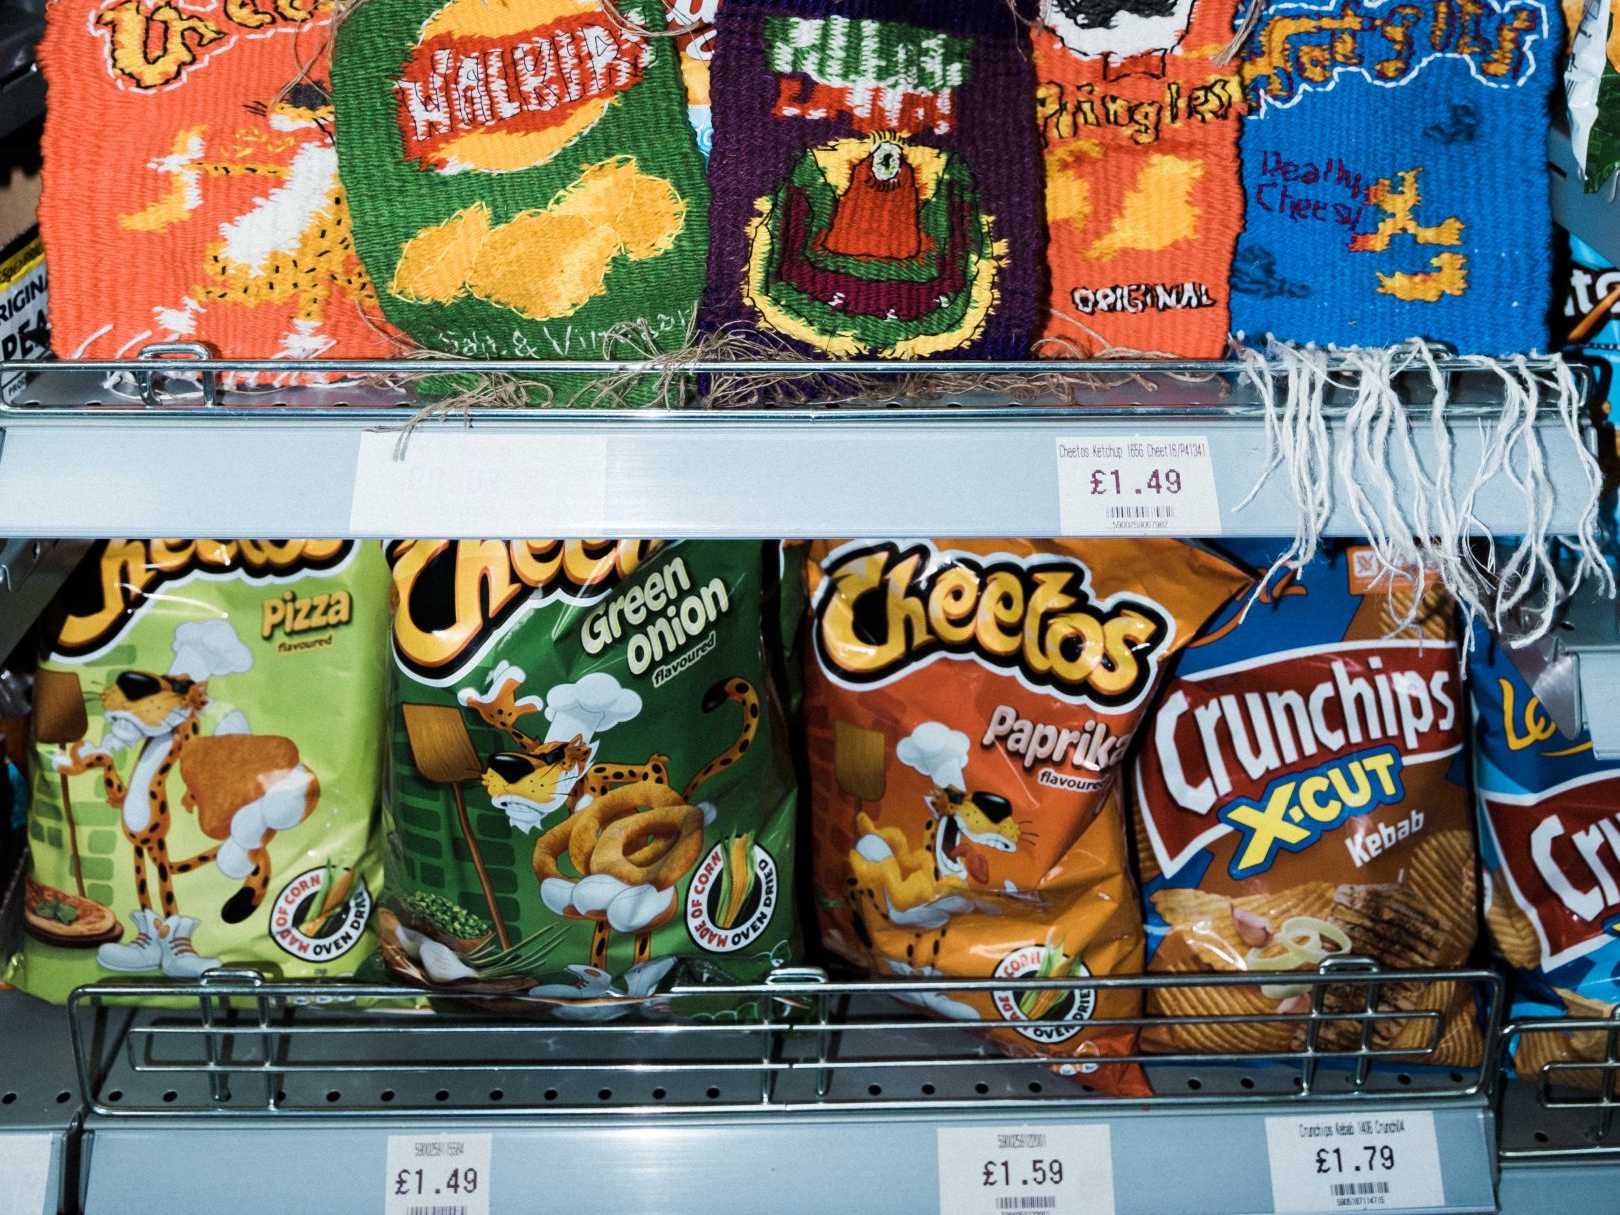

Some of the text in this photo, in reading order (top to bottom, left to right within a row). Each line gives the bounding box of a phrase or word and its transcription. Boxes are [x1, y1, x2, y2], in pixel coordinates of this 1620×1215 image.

[1257, 181, 1363, 229] Cheesy
[1071, 283, 1218, 315] ORIGINAL
[1059, 444, 1089, 458] Cheetos
[1092, 443, 1123, 459] Ketchup
[1090, 469, 1182, 495] £1.49
[262, 589, 351, 639] Pizza
[580, 556, 690, 655] Green
[823, 550, 1157, 695] Cheetos
[277, 635, 333, 654] flavoured
[653, 630, 717, 688] flavoured
[982, 704, 1134, 770] Paprika
[1155, 656, 1456, 815] Crunchips
[1346, 809, 1425, 868] Kebab
[694, 851, 721, 895] CORN
[276, 873, 320, 954] MAD OF CORN
[691, 899, 703, 919] OF
[731, 858, 774, 946] OVEN DRIED
[313, 931, 353, 956] OVEN
[395, 1167, 478, 1195] £1.49
[983, 1159, 1063, 1186] £1.59
[1316, 1145, 1394, 1173] £1.79
